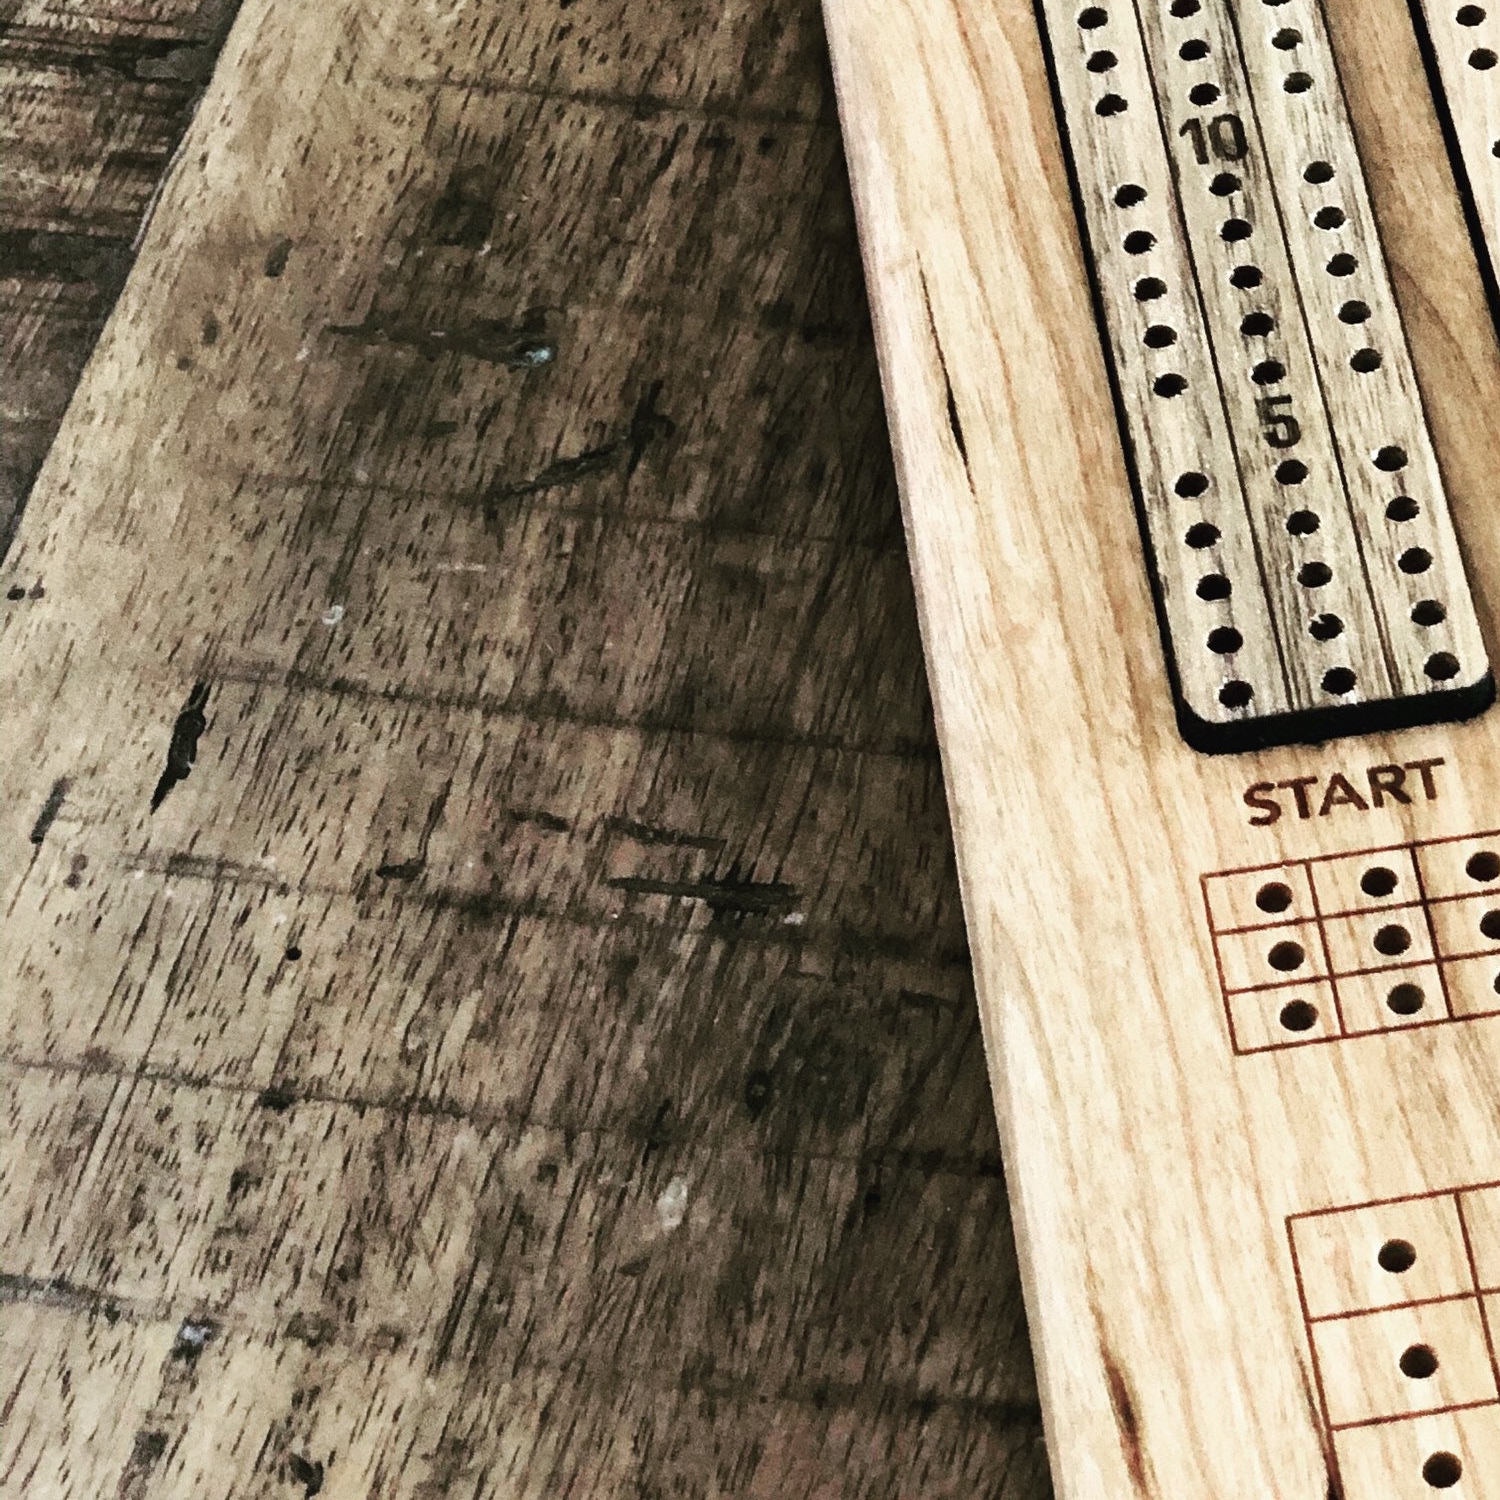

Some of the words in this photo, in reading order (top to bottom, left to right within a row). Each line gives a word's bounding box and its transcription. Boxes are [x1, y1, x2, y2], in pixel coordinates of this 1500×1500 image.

[1178, 113, 1250, 166] 10
[1254, 394, 1300, 449] 5
[1243, 757, 1446, 827] START
